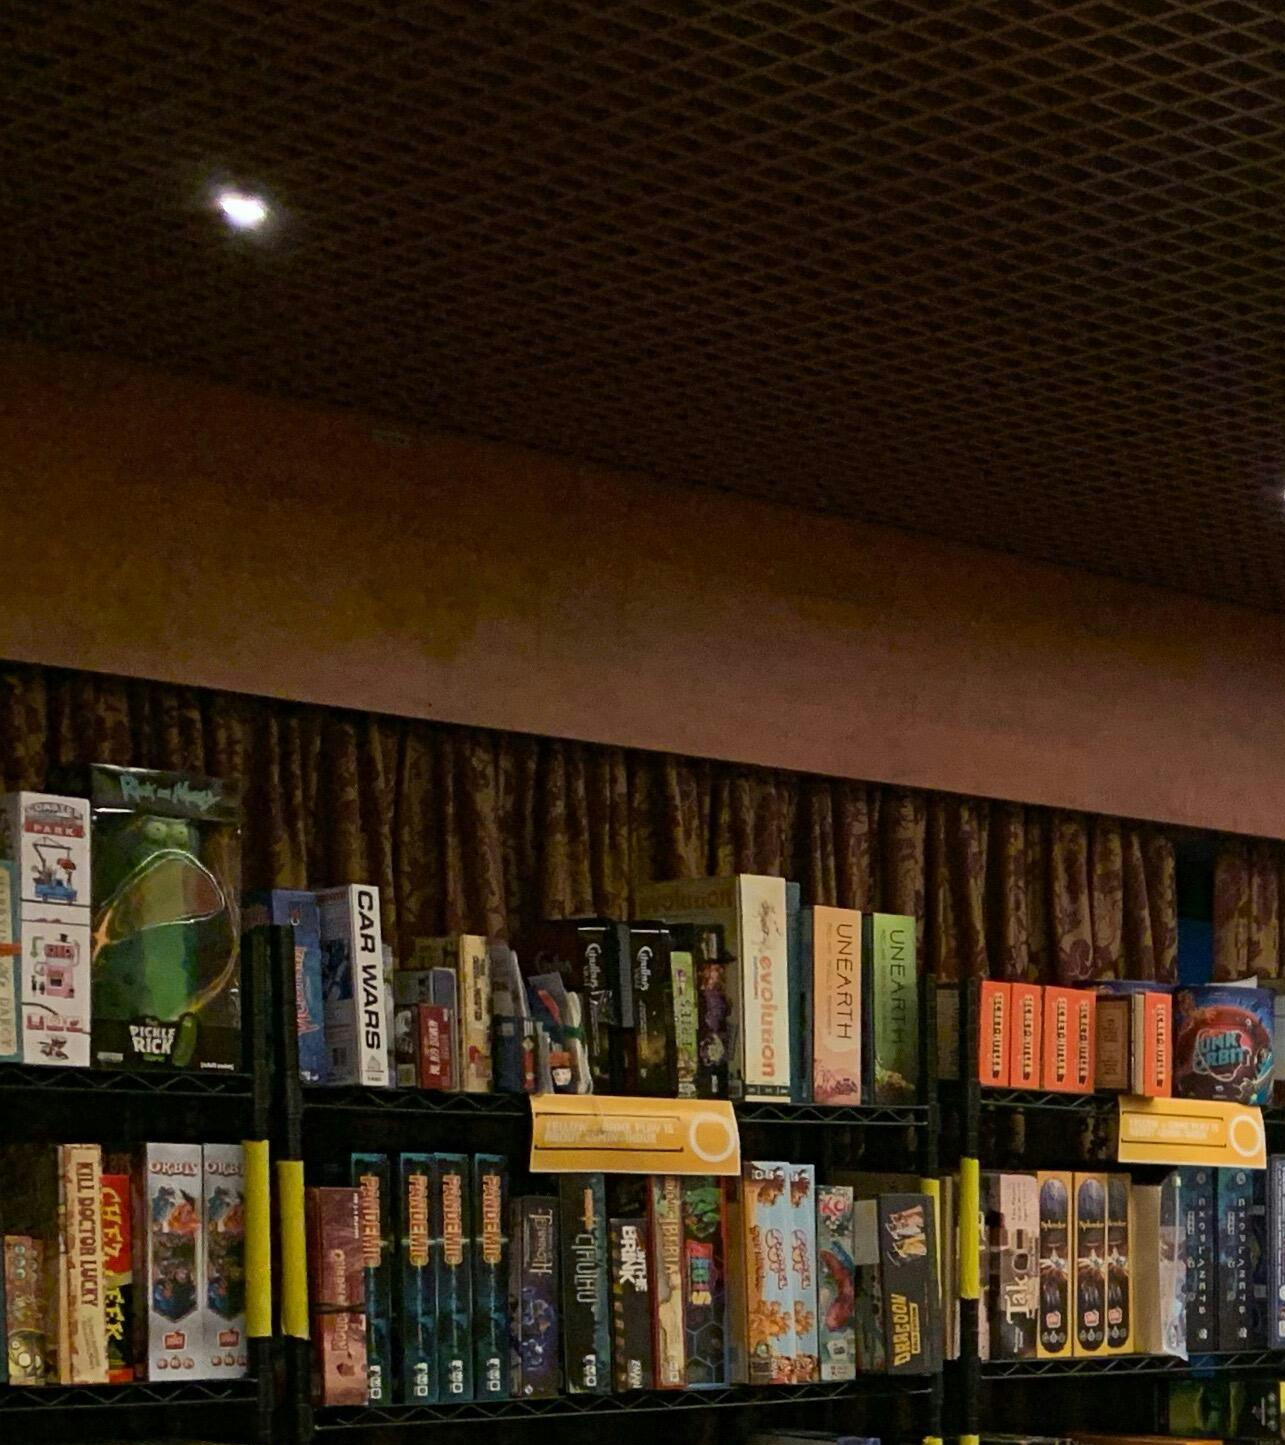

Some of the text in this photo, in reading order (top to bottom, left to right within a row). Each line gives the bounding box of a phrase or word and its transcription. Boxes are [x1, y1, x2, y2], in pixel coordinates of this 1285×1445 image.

[357, 890, 381, 1050] CAR WARS
[836, 924, 853, 1040] UNEARTH
[890, 929, 906, 1046] UNEARTH
[129, 1025, 176, 1037] PICKLE
[132, 1037, 174, 1054] RICK
[150, 1161, 199, 1176] ORBIS
[76, 1162, 98, 1307] KILL DOCTOR LUCKY
[409, 1174, 429, 1266] PANDEMIC
[443, 1175, 463, 1265] PANDEMIC
[483, 1175, 501, 1264] PANDEMIC
[620, 1226, 636, 1285] BRINK
